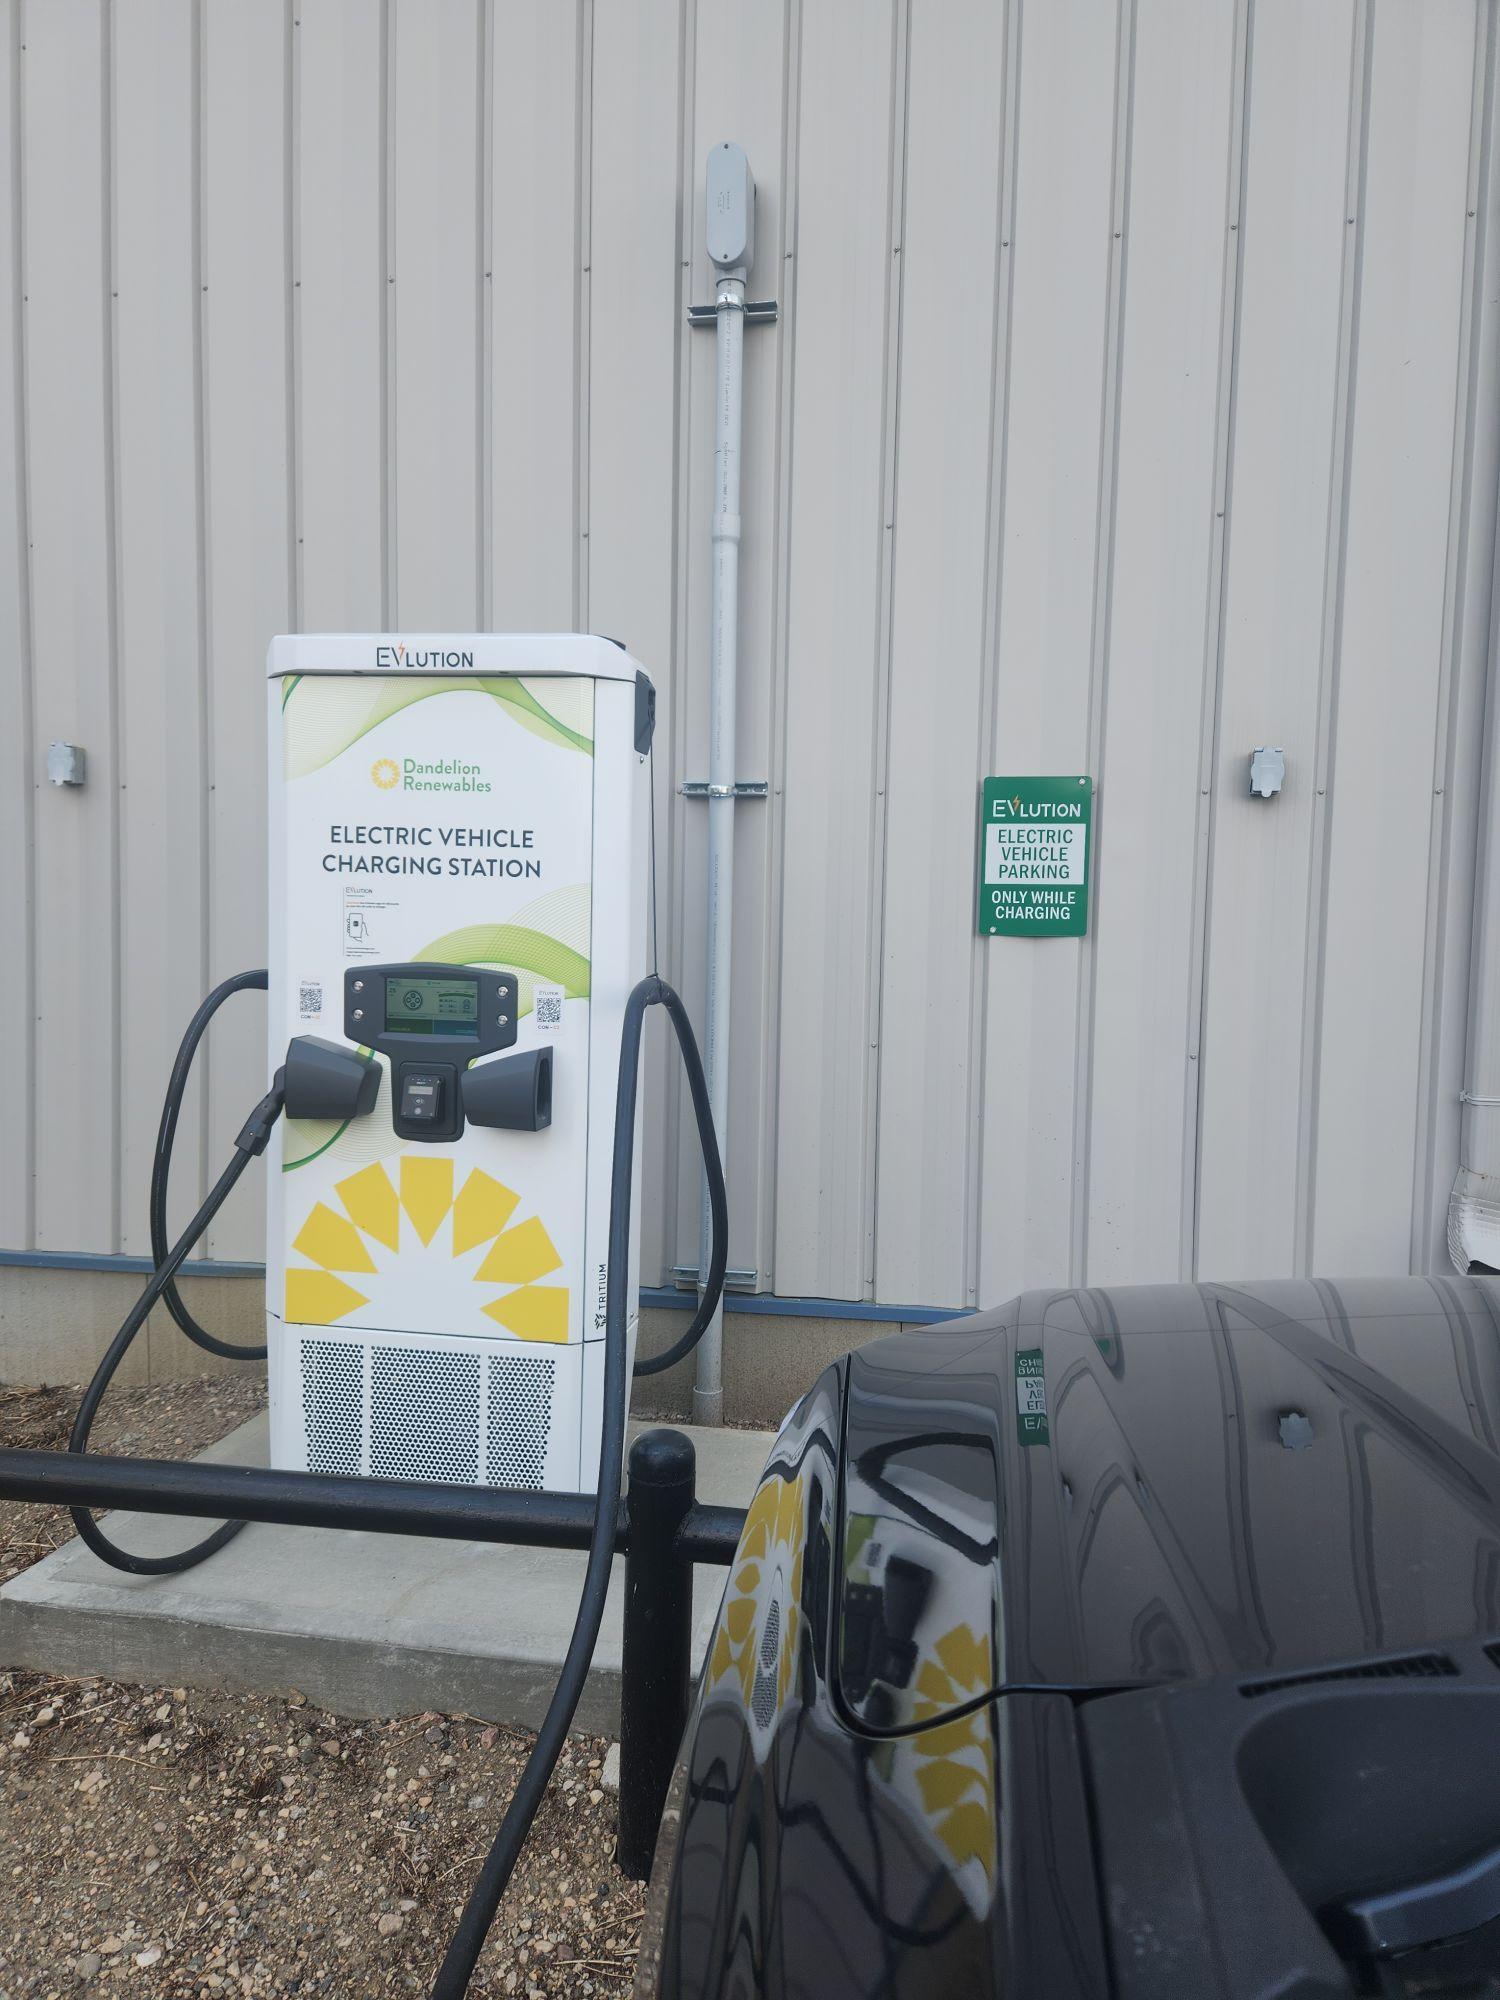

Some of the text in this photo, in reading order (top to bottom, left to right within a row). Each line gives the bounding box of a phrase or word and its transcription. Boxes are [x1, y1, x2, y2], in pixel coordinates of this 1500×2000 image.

[403, 758, 481, 775] Dandelion
[403, 775, 492, 793] Renewables
[330, 825, 534, 849] ELECTRIC VEHICLE
[998, 829, 1074, 844] ELECTRIC
[1001, 846, 1069, 862] VEHICLE
[322, 854, 541, 879] CHARGING STATION
[998, 864, 1071, 880] PARKING
[991, 890, 1077, 905] ONLY WHILE
[995, 905, 1071, 920] CHARGING
[598, 1263, 607, 1310] TRITIUM
